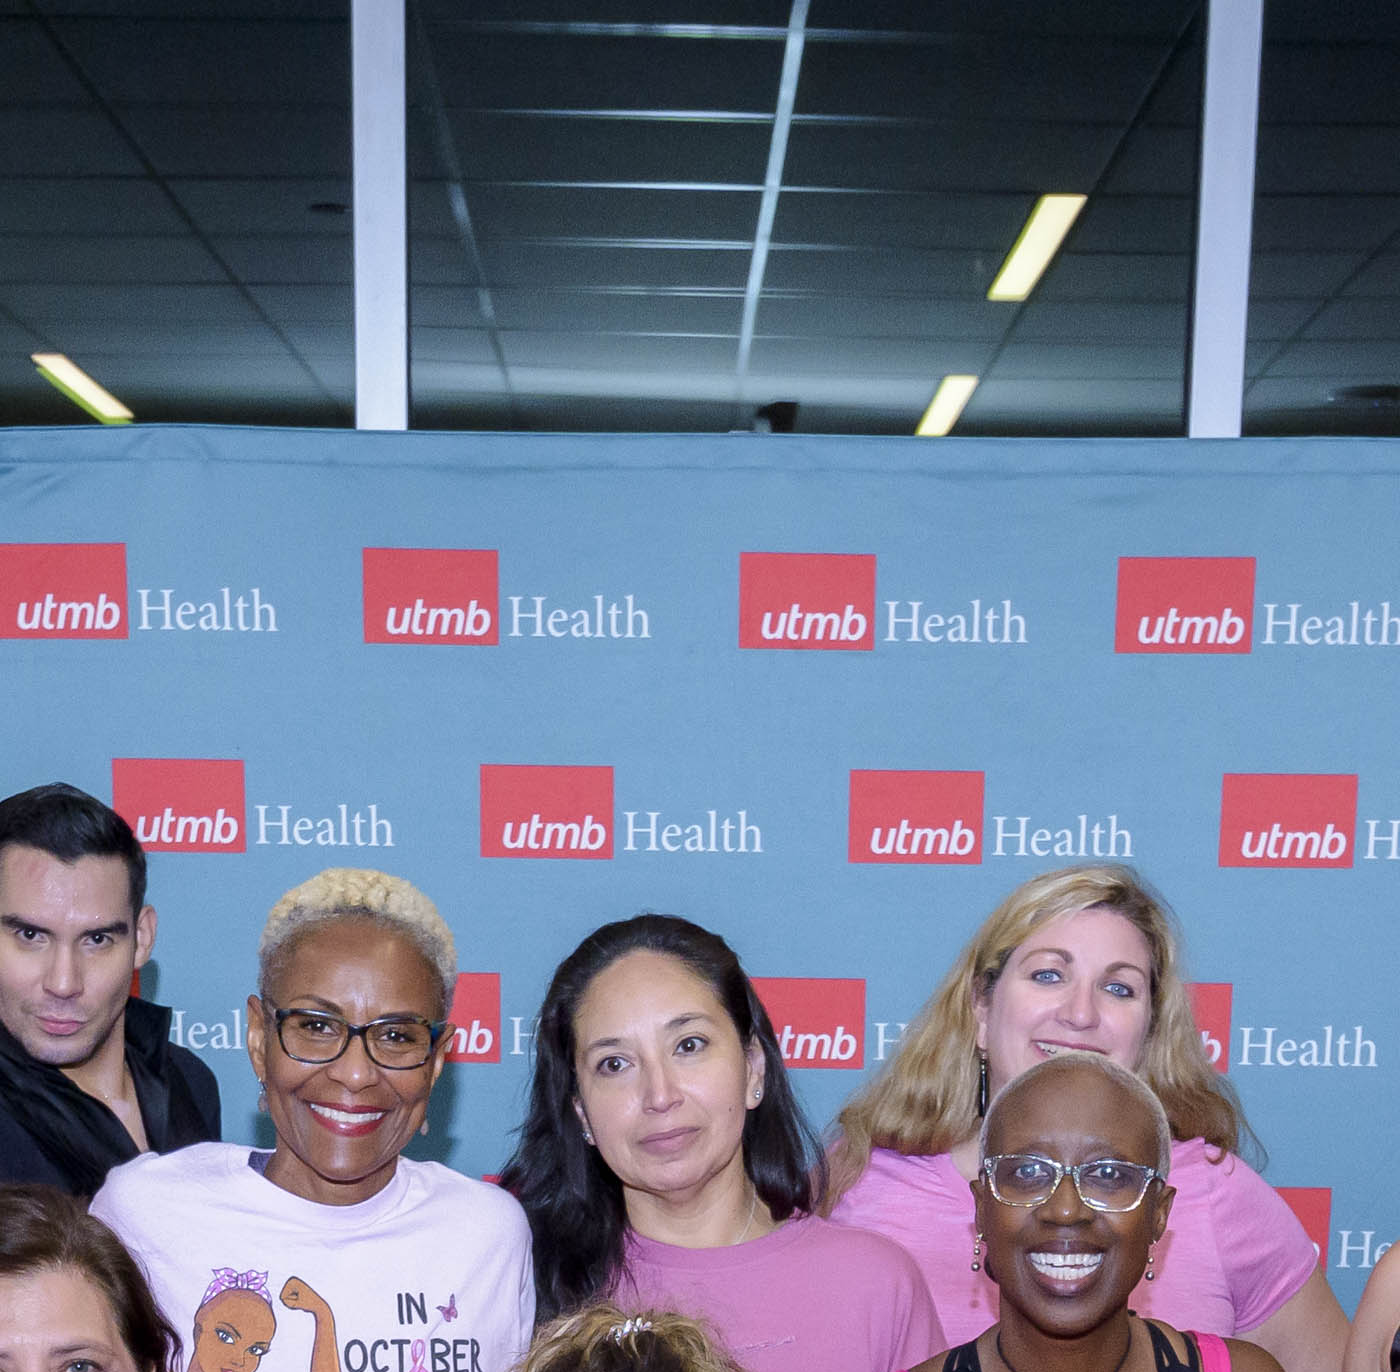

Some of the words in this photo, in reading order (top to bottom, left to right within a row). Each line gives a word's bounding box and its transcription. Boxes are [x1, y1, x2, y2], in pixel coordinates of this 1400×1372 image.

[17, 593, 121, 630] utmb
[137, 587, 278, 632] Health
[386, 598, 491, 636] utmb
[508, 594, 651, 638] Health
[761, 603, 867, 641] utmb
[884, 599, 1028, 643] Health
[1138, 607, 1245, 645] utmb
[136, 807, 239, 844] utmb
[255, 803, 394, 847] Health
[502, 814, 606, 851] utmb
[623, 810, 763, 853] Health
[870, 819, 975, 856] utmb
[992, 814, 1133, 857] Health
[1241, 823, 1347, 859] utmb
[170, 1008, 247, 1050] Heal
[778, 1025, 857, 1061] tmb
[1238, 1025, 1377, 1067] Health
[397, 1292, 428, 1325] IN
